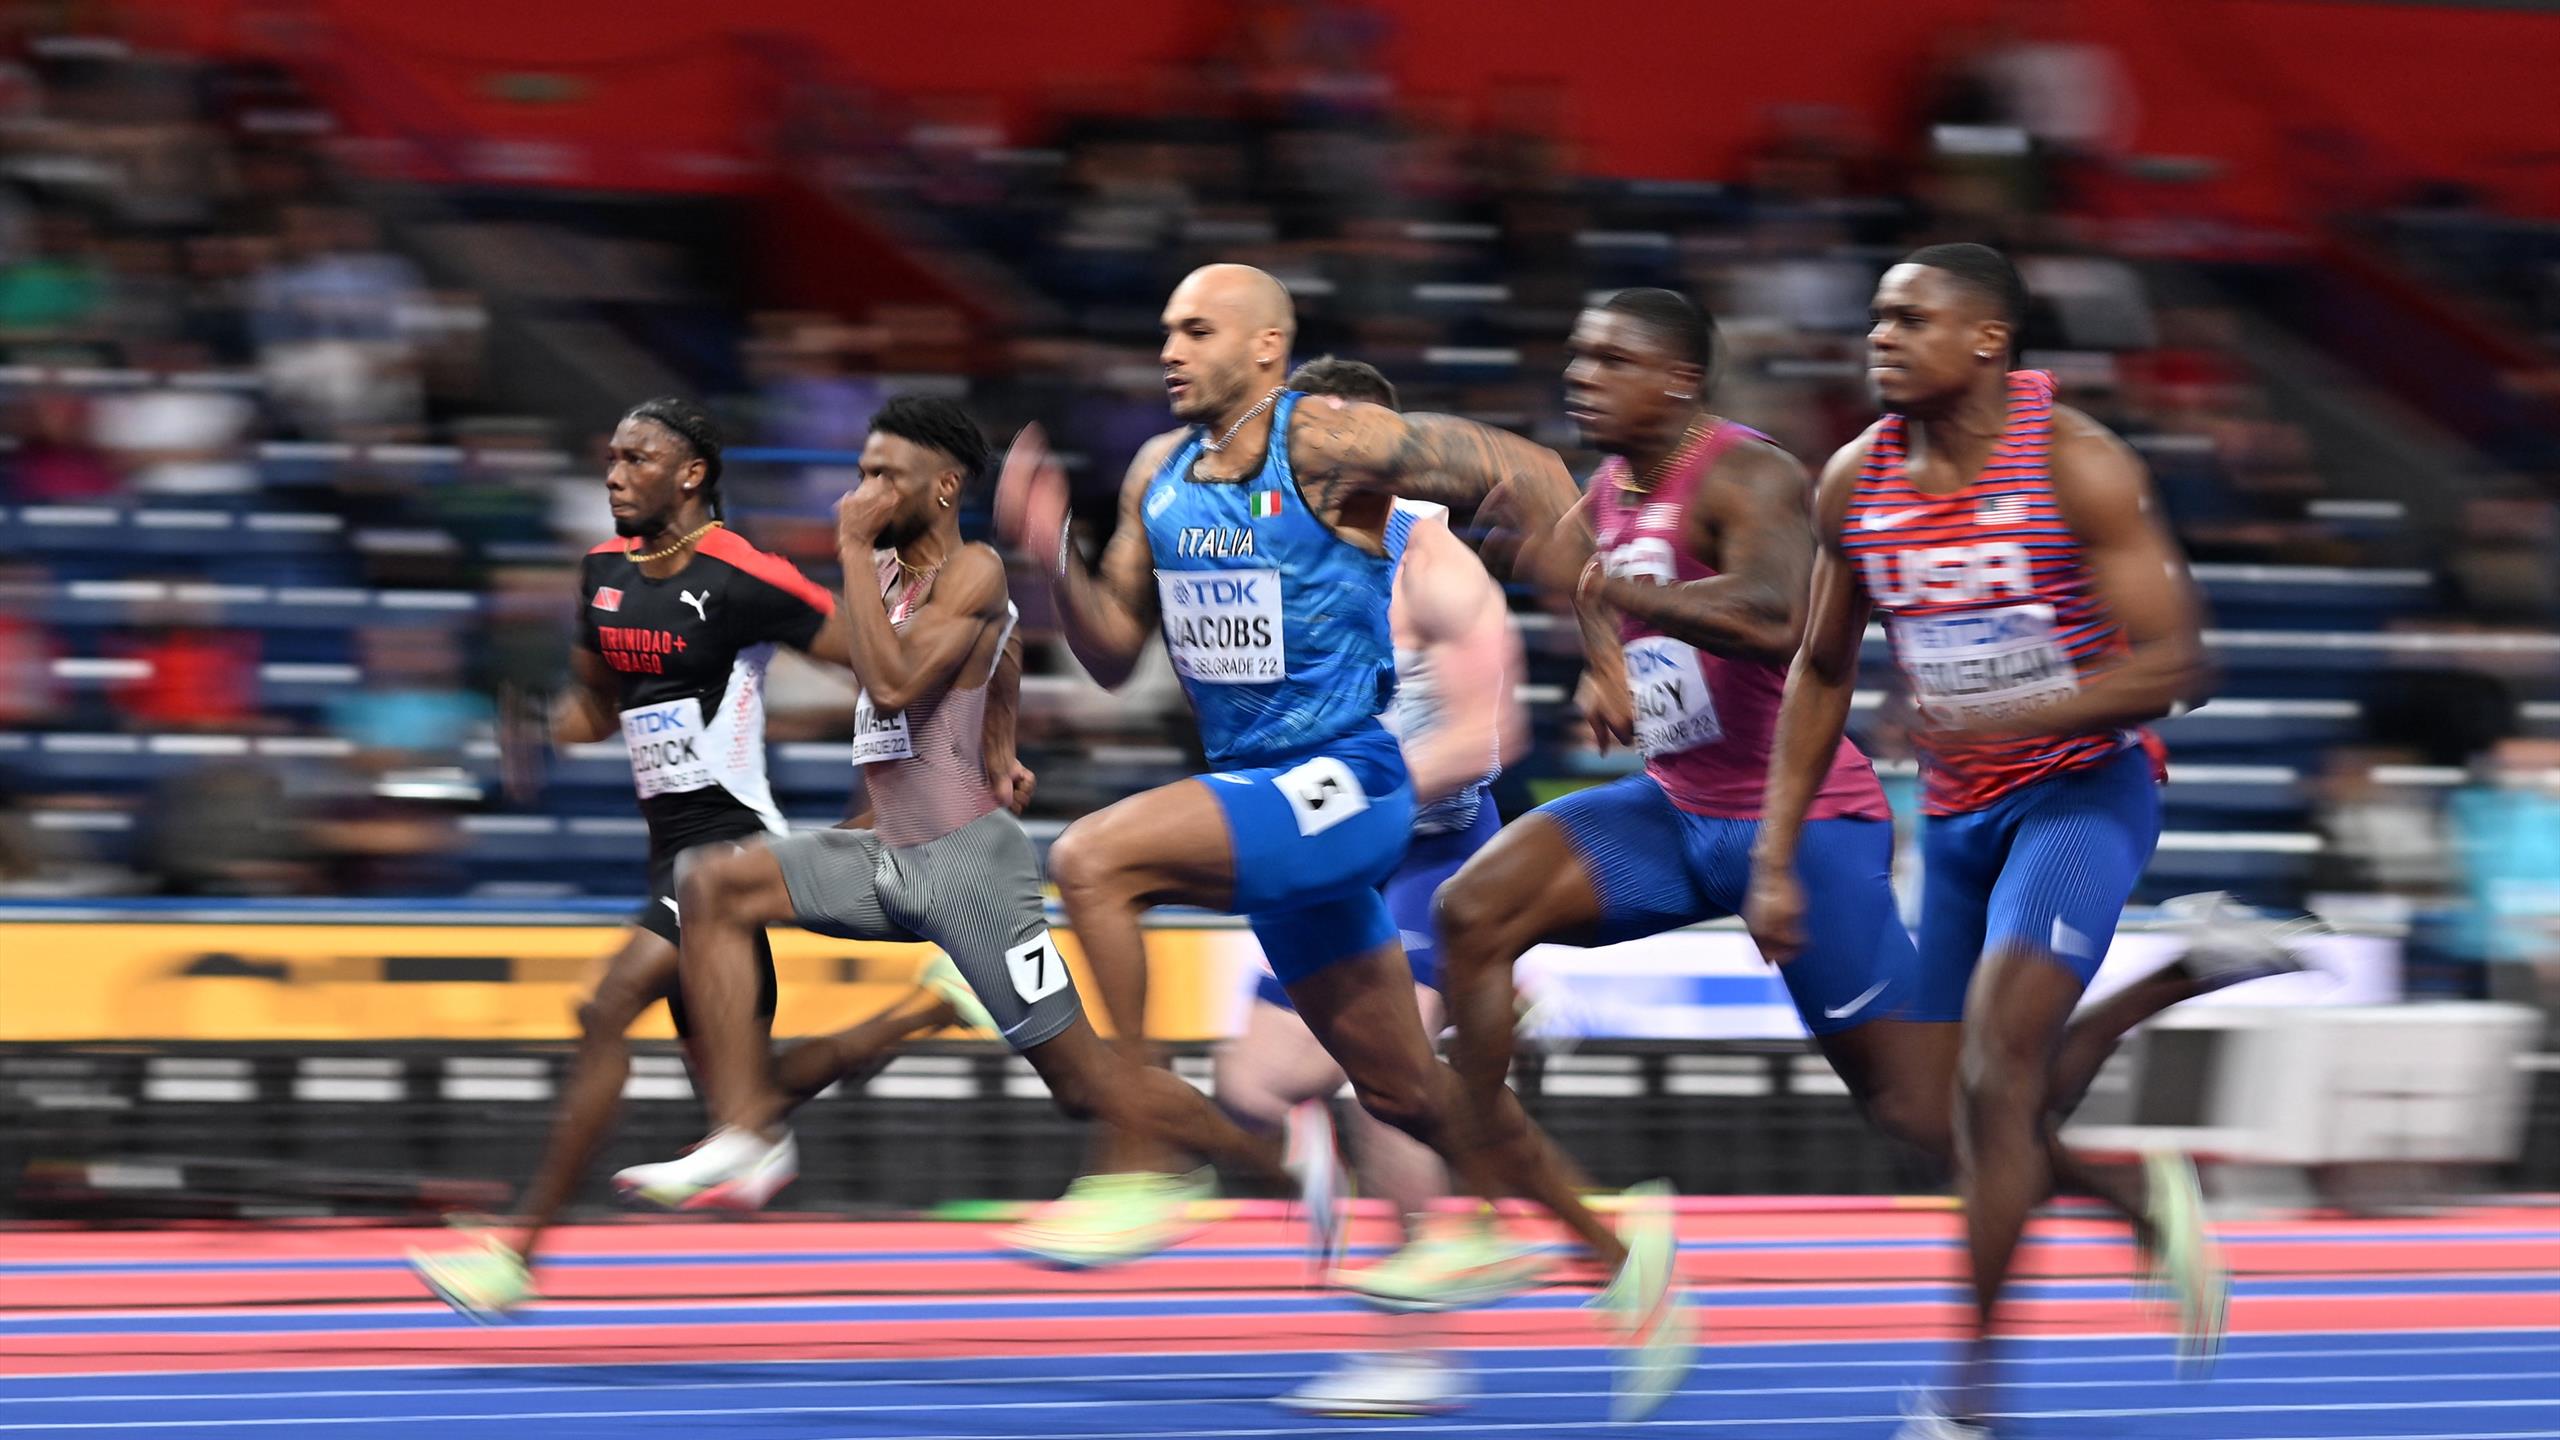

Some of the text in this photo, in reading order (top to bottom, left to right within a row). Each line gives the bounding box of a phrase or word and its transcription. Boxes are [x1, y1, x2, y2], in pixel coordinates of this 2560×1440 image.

[1177, 527, 1255, 558] ITALIA
[1862, 541, 2034, 606] USA
[1187, 577, 1259, 607] TDK
[1174, 614, 1272, 649] JACOBS
[603, 650, 664, 675] TOBAGO
[1258, 658, 1278, 675] 22
[632, 707, 685, 735] TDK
[1023, 945, 1045, 992] 7
